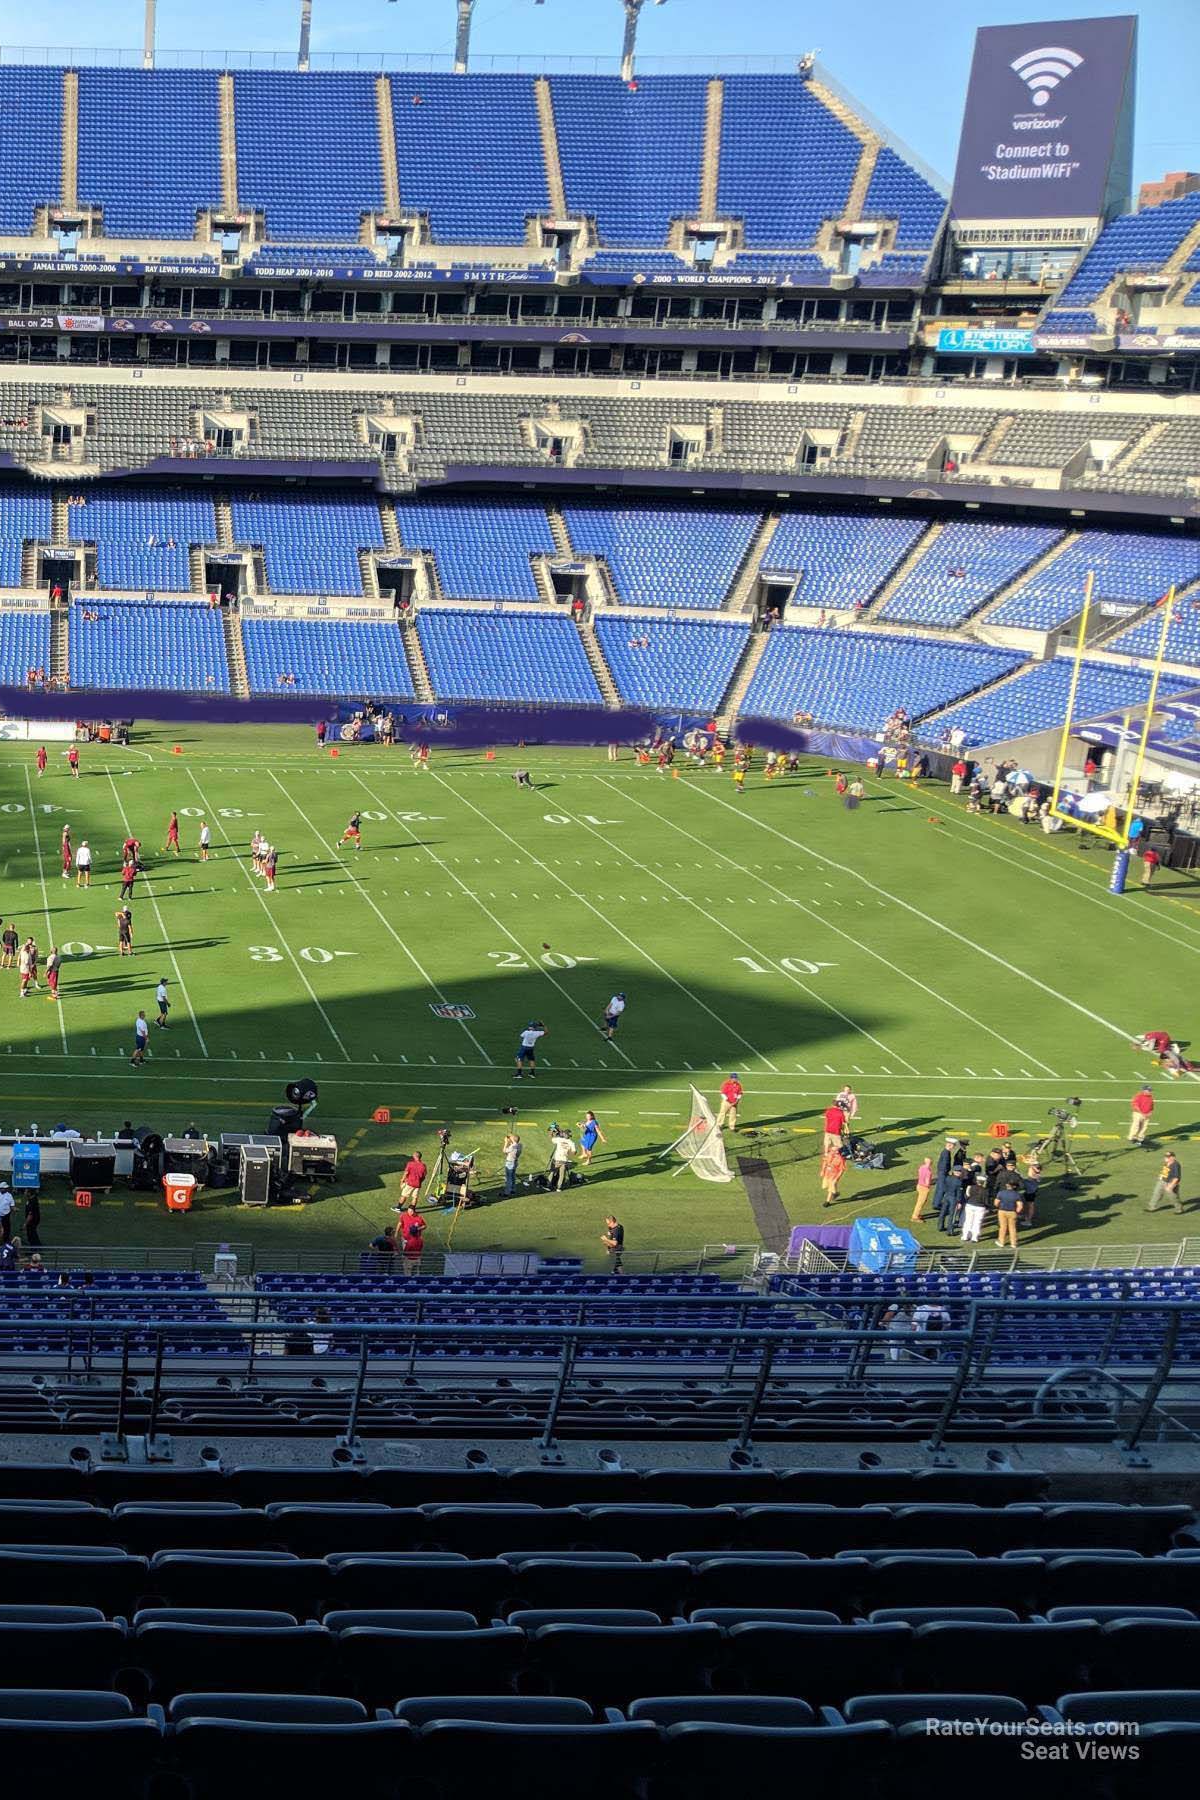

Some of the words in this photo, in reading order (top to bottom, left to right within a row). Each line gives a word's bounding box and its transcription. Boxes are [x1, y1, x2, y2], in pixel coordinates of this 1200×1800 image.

[1012, 118, 1061, 130] verizon
[995, 142, 1052, 158] Connect
[1055, 142, 1070, 156] to
[33, 263, 55, 271] JAMAL
[80, 264, 116, 272] 2000-2006
[145, 265, 157, 273] RAY
[181, 266, 216, 274] 1996-2012
[254, 267, 274, 276] TODD
[275, 268, 295, 276] HEAP
[296, 269, 334, 277] 2001-2010
[363, 270, 373, 278] ED
[374, 270, 392, 278] REED
[394, 270, 433, 279] 2002-2012
[464, 272, 505, 280] SMYTH
[652, 275, 672, 283] 2000
[677, 275, 705, 283] WORLD
[707, 275, 752, 284] CHAMPIONS
[757, 276, 777, 284] 2012
[8, 319, 26, 327] BALL
[28, 320, 38, 328] ON
[40, 317, 53, 328] 25
[964, 330, 1032, 340] STRATEGIC
[962, 340, 1030, 350] FACTORY
[247, 945, 335, 964] 30
[487, 951, 578, 970] 20
[733, 956, 820, 975] 10
[377, 1111, 388, 1122] 30
[995, 1124, 1007, 1136] 10
[77, 1192, 90, 1206] 40
[173, 1189, 187, 1203] G
